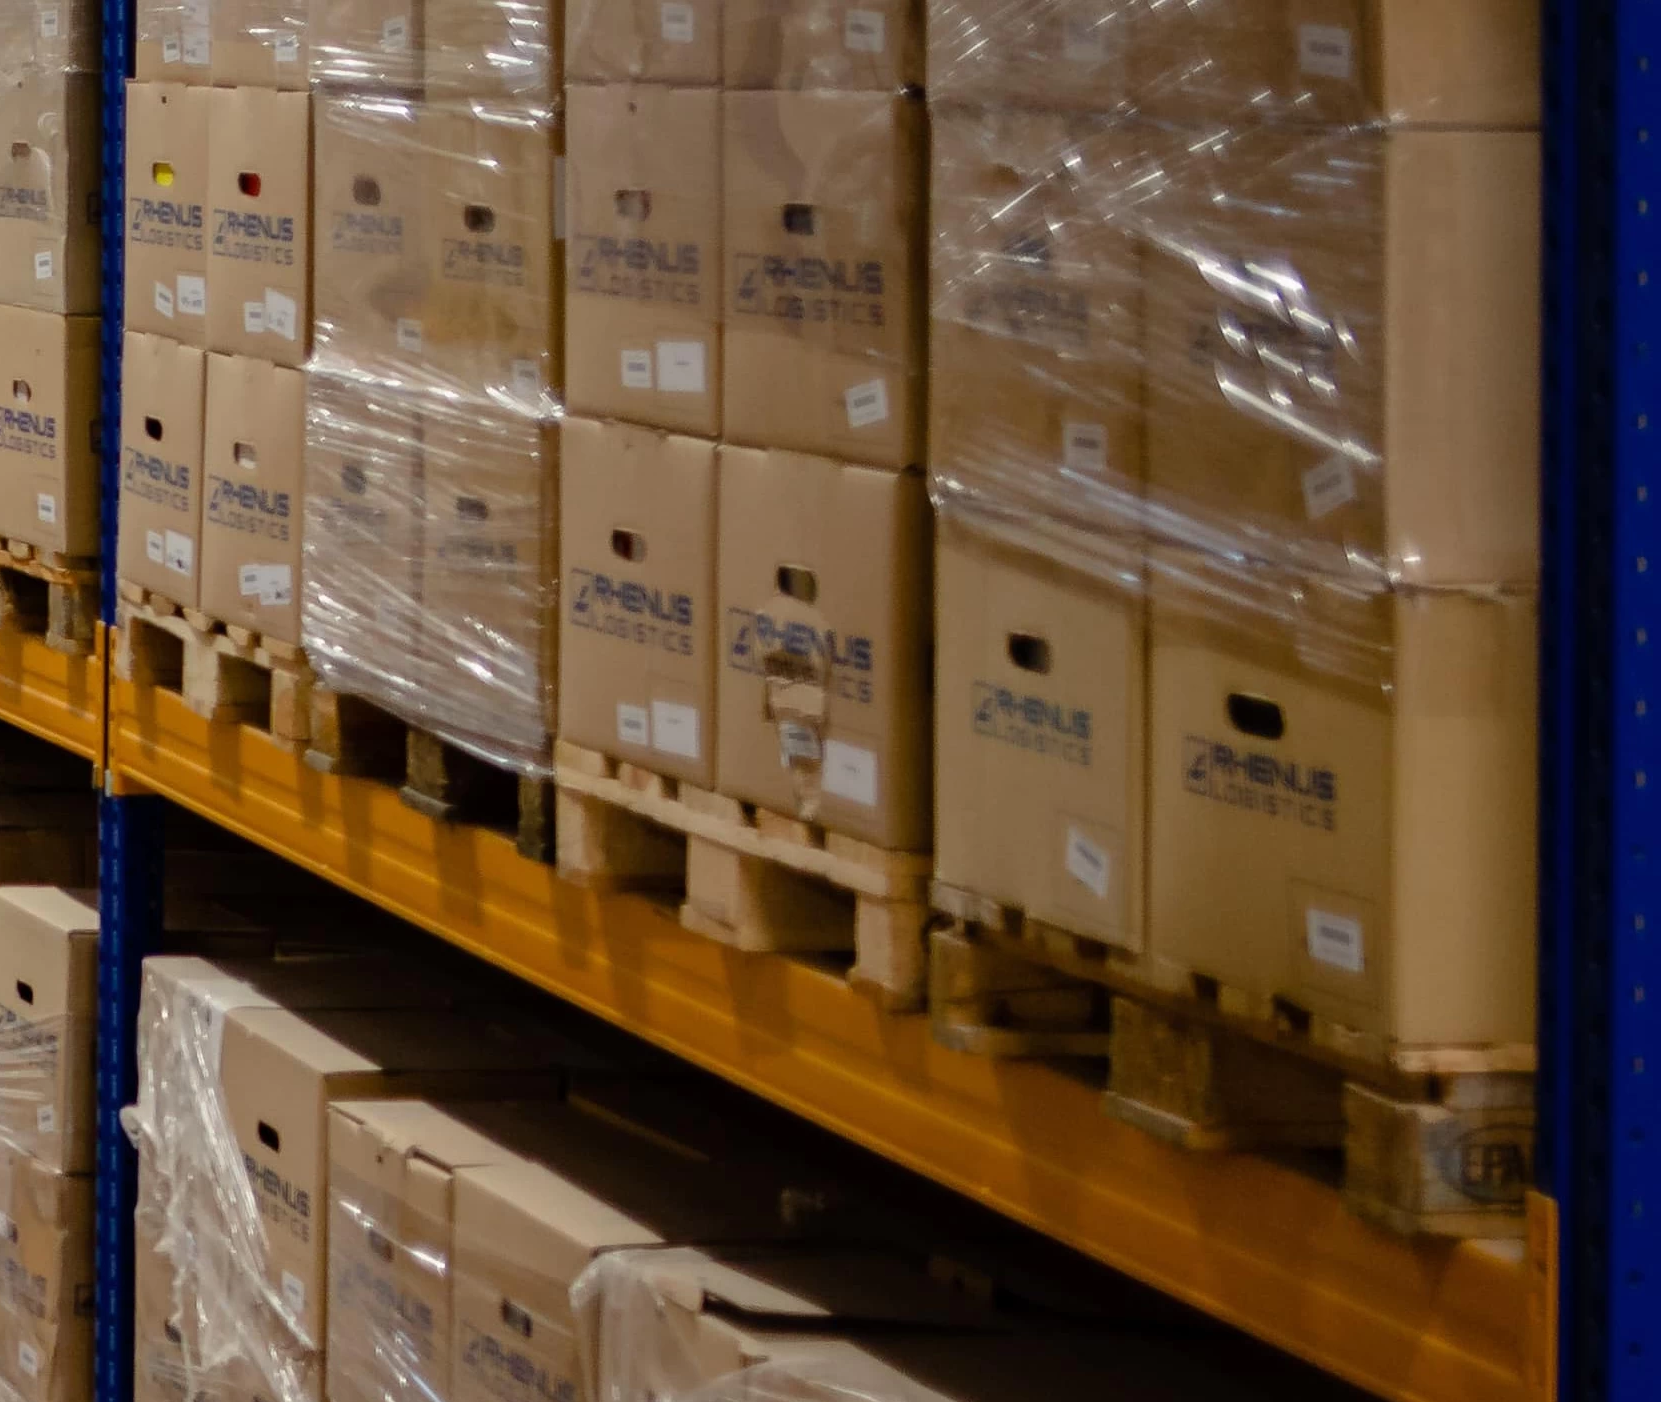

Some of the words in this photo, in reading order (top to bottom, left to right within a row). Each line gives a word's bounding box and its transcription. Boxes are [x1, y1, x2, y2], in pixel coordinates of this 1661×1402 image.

[143, 199, 203, 228] RHENUS
[227, 211, 294, 242] RHENUS
[598, 237, 699, 275] RHENUS
[764, 256, 883, 295] RHENUS
[4, 408, 56, 438] RHENUS
[135, 452, 189, 490] RHENUS
[222, 480, 290, 518] RHENUS
[596, 574, 693, 627] RHENUS
[756, 611, 873, 671] RHENUS
[996, 687, 1092, 741] RHENUS
[1213, 742, 1337, 803] RHENUS
[244, 1153, 311, 1218] RHENUS
